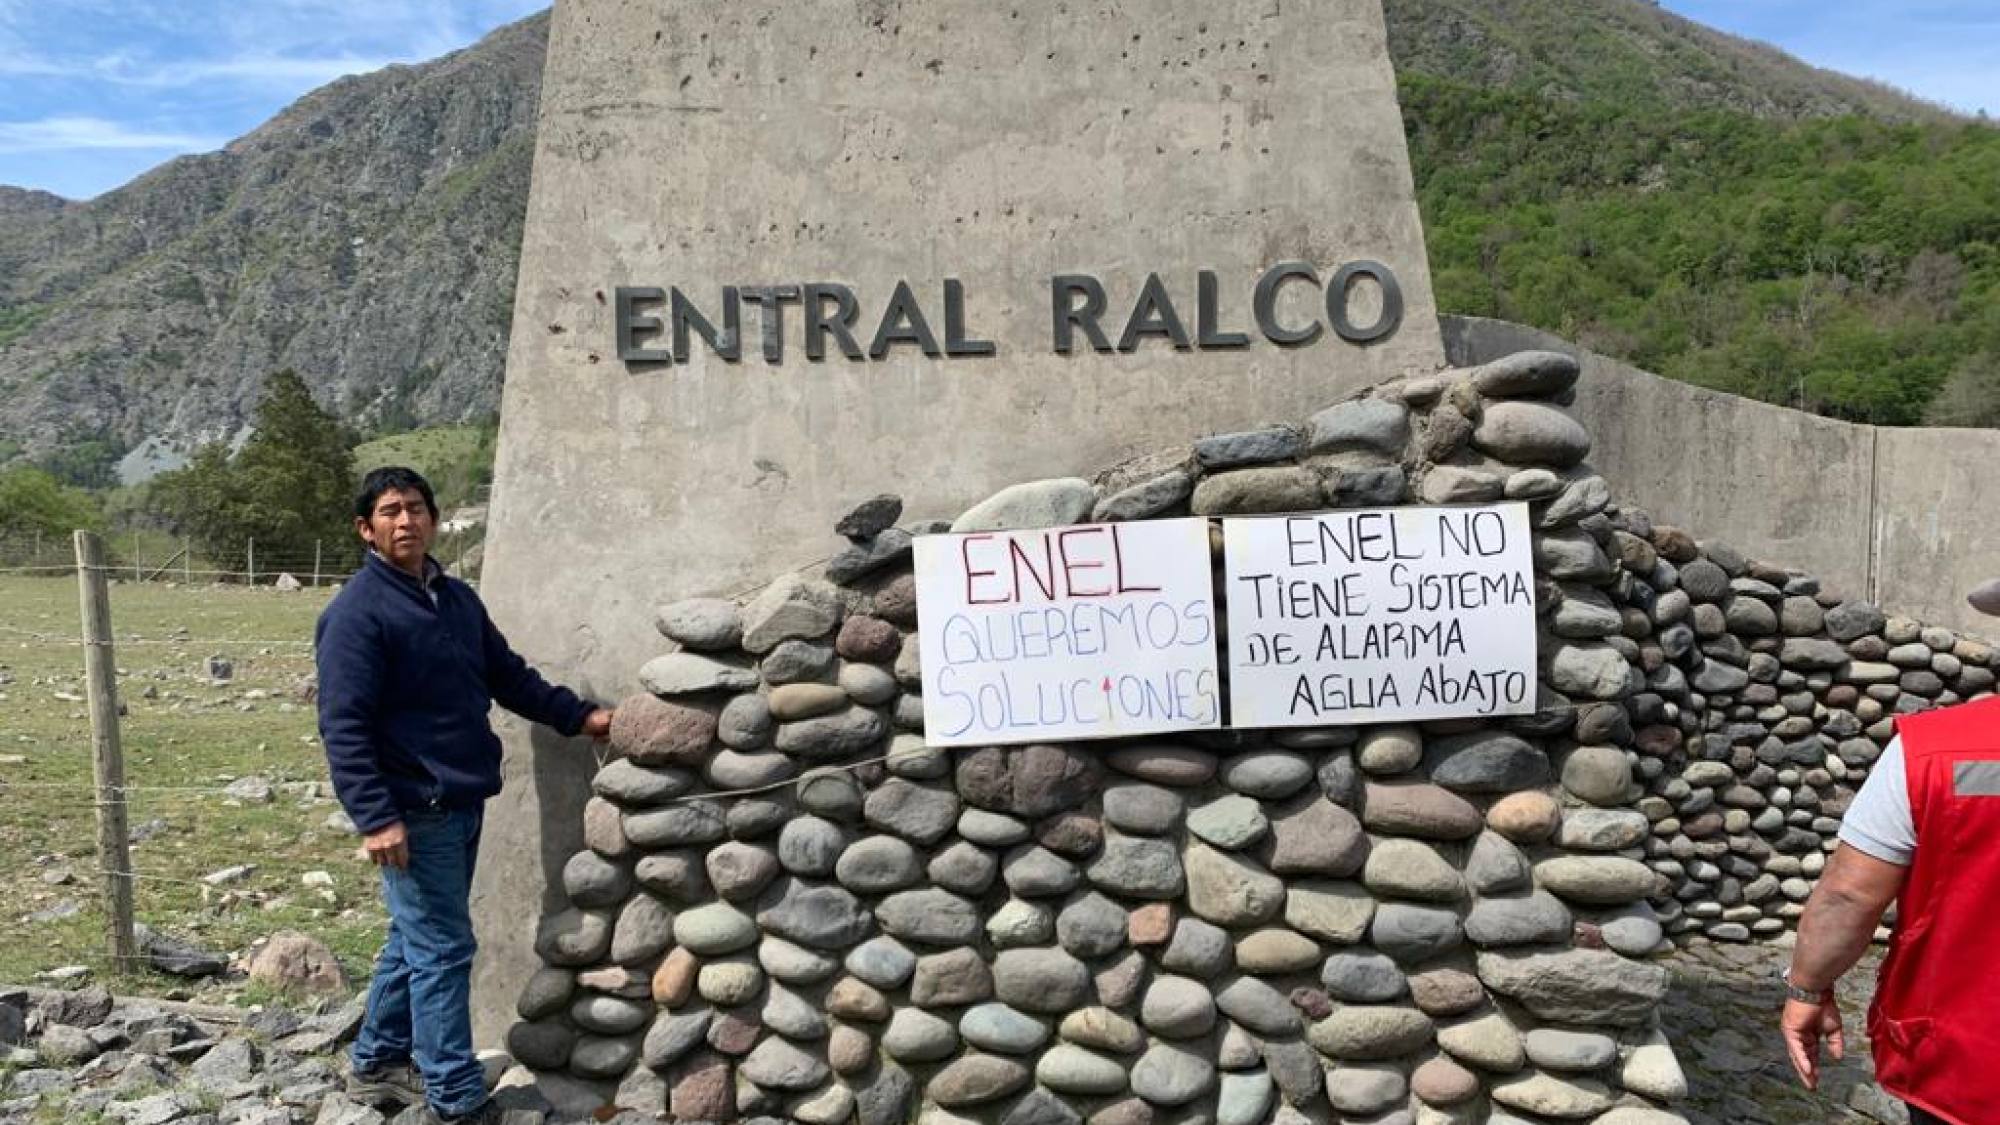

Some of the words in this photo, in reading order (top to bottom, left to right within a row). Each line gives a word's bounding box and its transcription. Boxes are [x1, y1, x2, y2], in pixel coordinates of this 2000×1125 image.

[615, 278, 997, 367] ENTRAL
[1051, 260, 1401, 354] RALCO
[962, 525, 1162, 605] ENEL
[1287, 512, 1424, 567] ENEL
[1439, 511, 1506, 557] NO
[943, 600, 1211, 665] QUEREMOS
[1240, 632, 1300, 667] DE
[1316, 618, 1466, 662] ALARMA
[1289, 673, 1400, 717] AGUA
